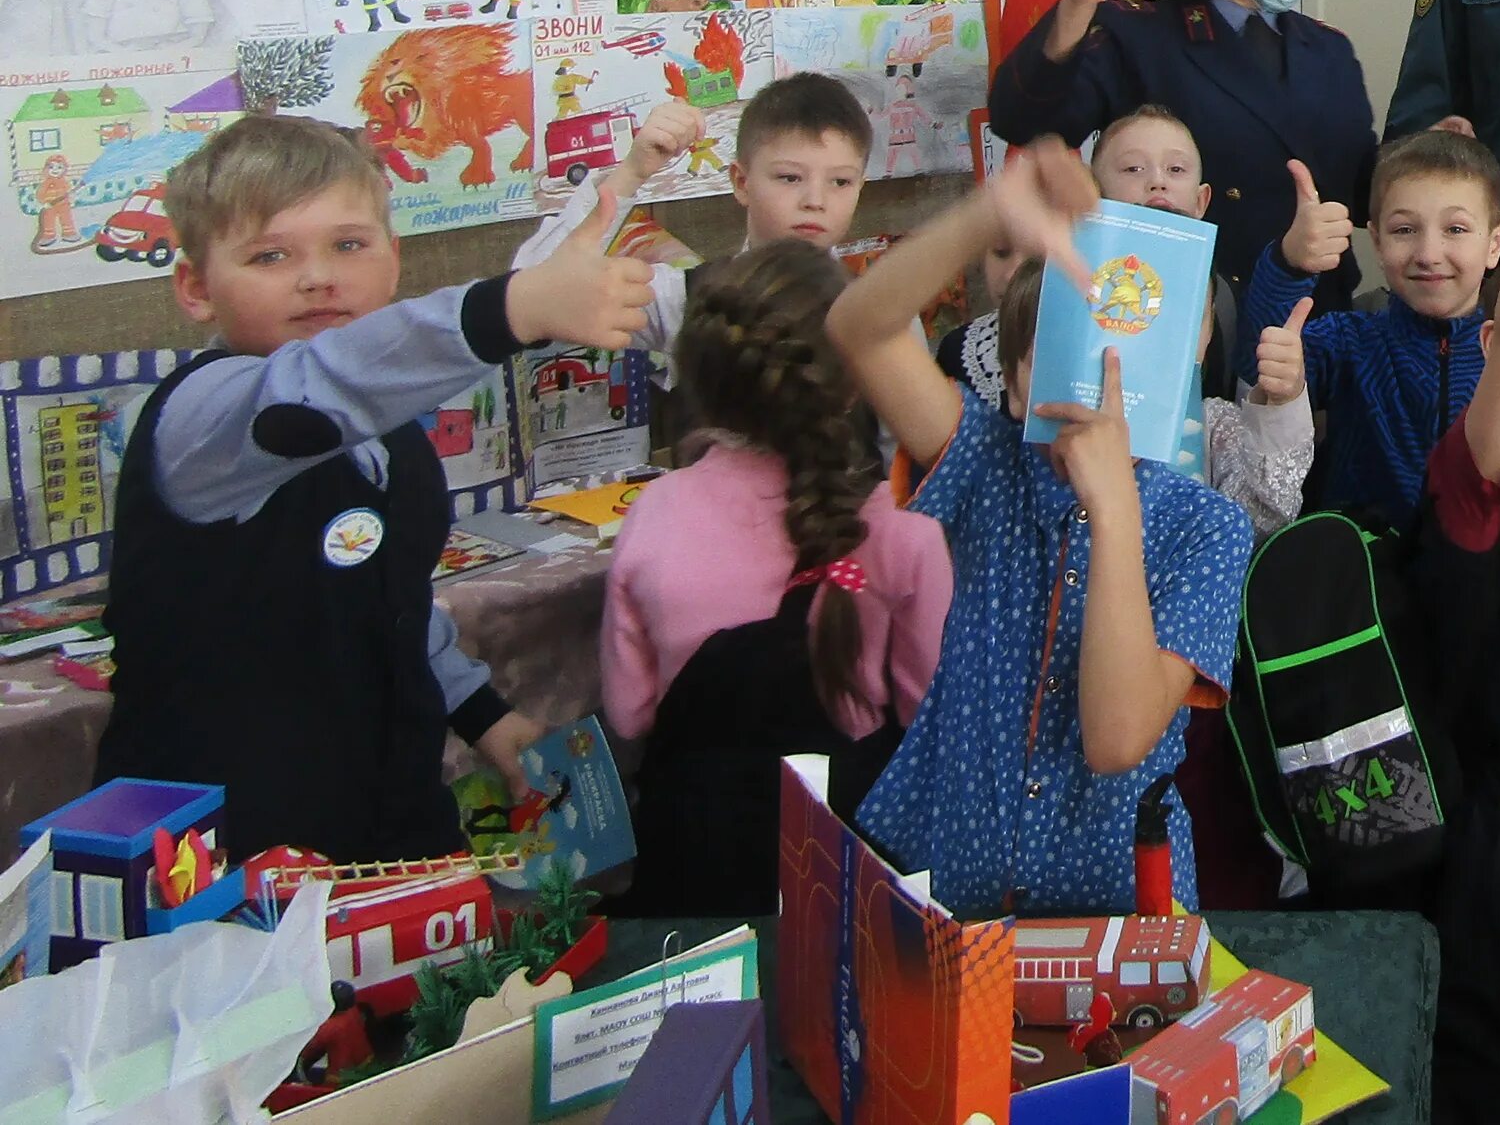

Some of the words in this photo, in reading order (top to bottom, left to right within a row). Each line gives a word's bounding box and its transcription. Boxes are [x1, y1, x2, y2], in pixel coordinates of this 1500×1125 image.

[535, 16, 604, 41] ЗВОНИ
[534, 44, 551, 58] 01
[552, 46, 571, 56] или
[571, 40, 592, 54] 112
[89, 62, 176, 80] пожарные
[570, 136, 585, 148] 01
[425, 901, 476, 951] 01
